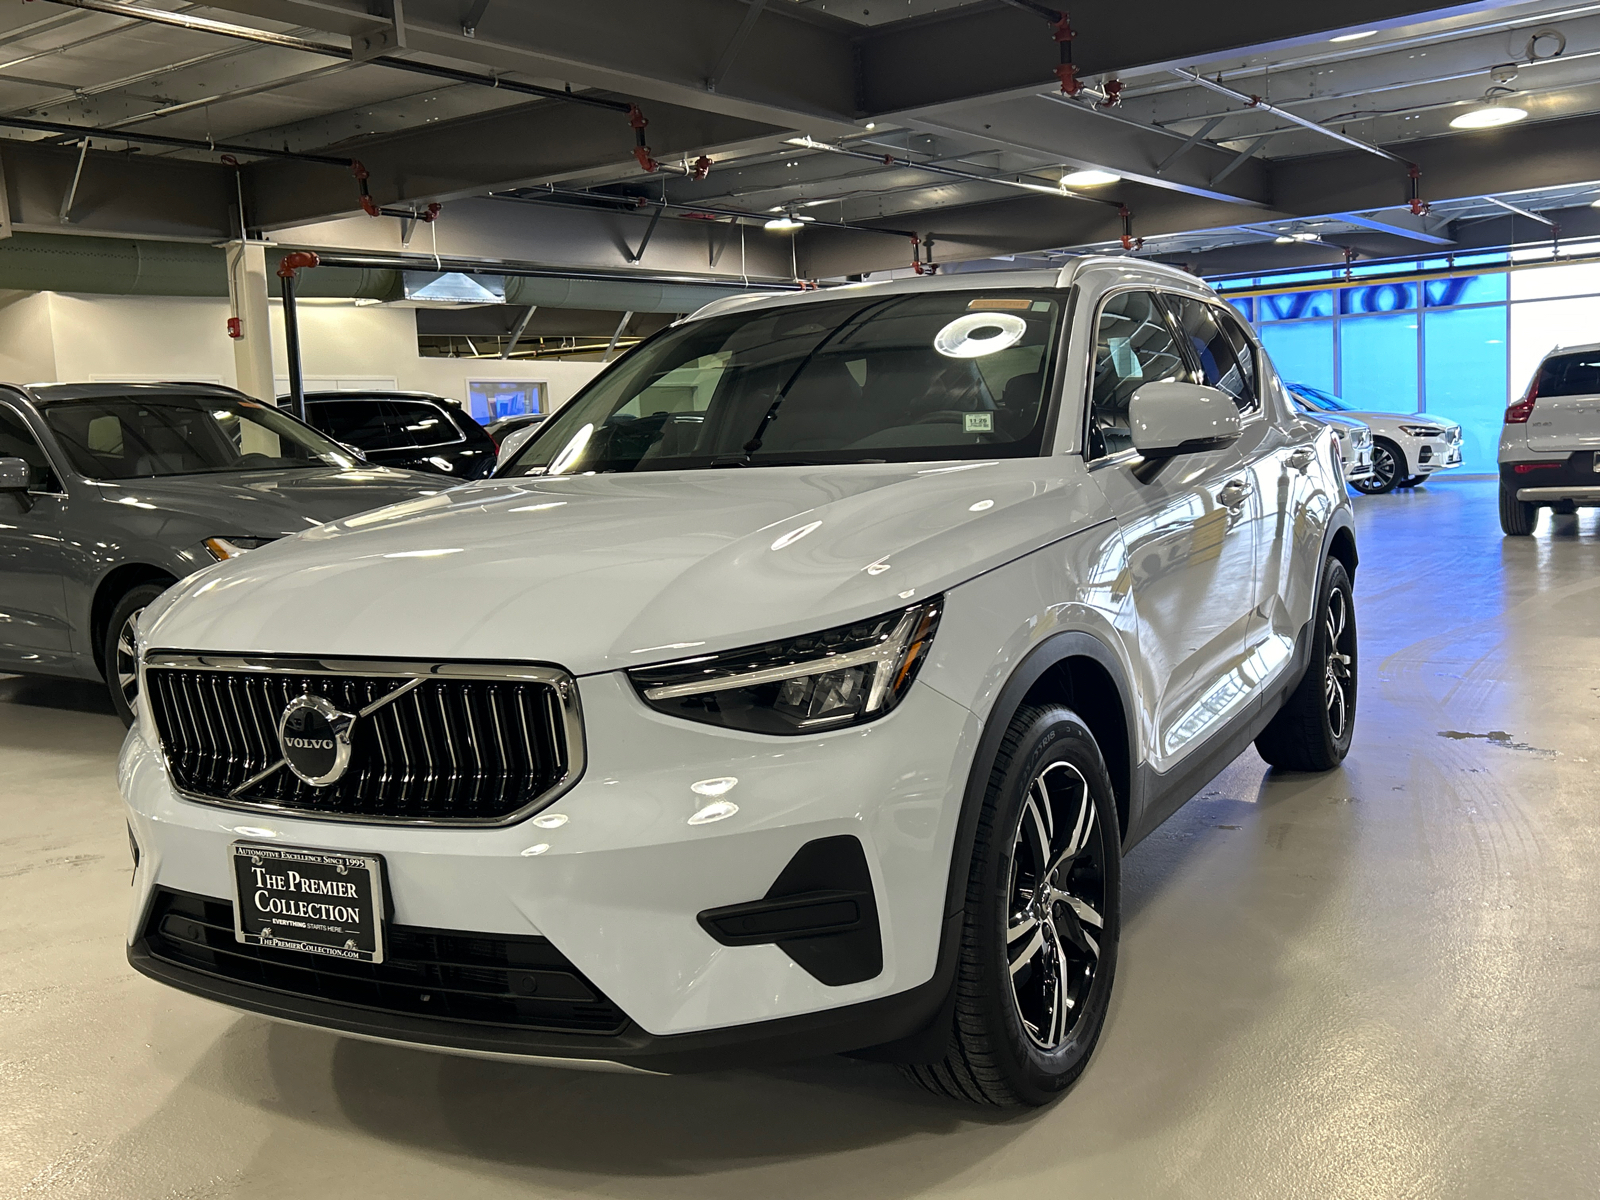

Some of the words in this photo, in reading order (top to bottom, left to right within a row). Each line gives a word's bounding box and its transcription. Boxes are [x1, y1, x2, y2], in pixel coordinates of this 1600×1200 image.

[284, 737, 333, 750] VOLVO
[238, 847, 279, 858] AUTOMOTIVE
[281, 852, 322, 863] EXCELLENCE
[323, 856, 344, 865] SINCE
[346, 859, 365, 867] 1995
[251, 867, 286, 890] THE
[287, 870, 358, 899] PREMIER
[254, 890, 360, 924] COLLECTION
[272, 918, 306, 928] EVERYTHING
[306, 923, 327, 932] STARTS
